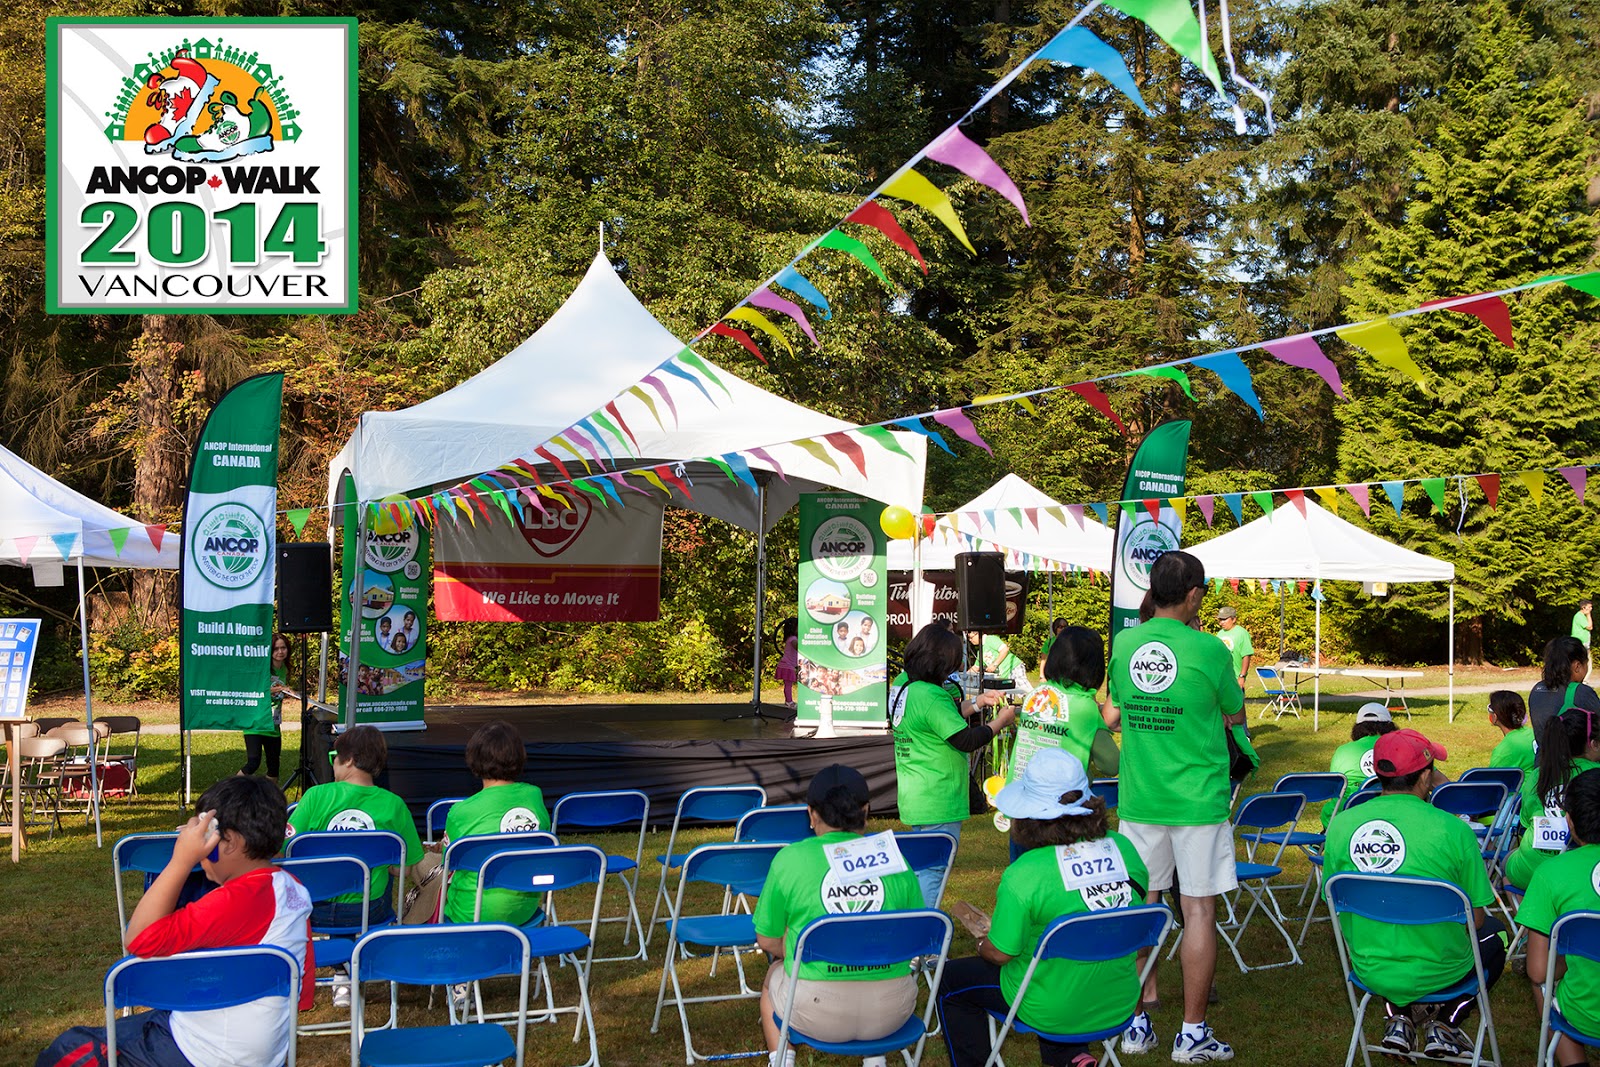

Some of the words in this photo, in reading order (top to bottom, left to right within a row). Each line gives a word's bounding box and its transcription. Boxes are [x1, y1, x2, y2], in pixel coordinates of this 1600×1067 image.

[204, 442, 227, 451] ANCOP
[228, 442, 272, 452] International
[212, 454, 261, 468] CANADA
[1139, 480, 1178, 494] CANADA
[525, 507, 578, 530] LBC
[204, 537, 259, 553] ANCOP
[819, 541, 866, 553] ANCOP
[482, 591, 506, 605] We
[509, 591, 540, 605] Like
[544, 592, 558, 605] to
[561, 592, 603, 605] Move
[606, 592, 619, 605] It
[198, 621, 225, 634] Build
[226, 623, 234, 635] A
[235, 623, 264, 636] Home
[1123, 617, 1141, 627] Buil
[191, 643, 235, 657] Sponsor
[235, 644, 243, 657] A
[1133, 661, 1173, 673] ANCOP
[190, 689, 206, 697] VISIT
[1132, 694, 1170, 702] www.ancop.ca
[1123, 701, 1153, 712] Sponsor
[1161, 706, 1184, 715] child
[1127, 714, 1145, 722] build
[1152, 716, 1175, 725] home
[1043, 724, 1069, 737] WALK
[1137, 721, 1152, 730] the
[1153, 724, 1175, 732] poor
[1542, 830, 1567, 841] 008
[1354, 843, 1401, 855] ANCOP
[843, 852, 890, 872] 0423
[1071, 857, 1116, 877] 0372
[827, 885, 879, 898] ANCOP
[827, 965, 844, 973] for
